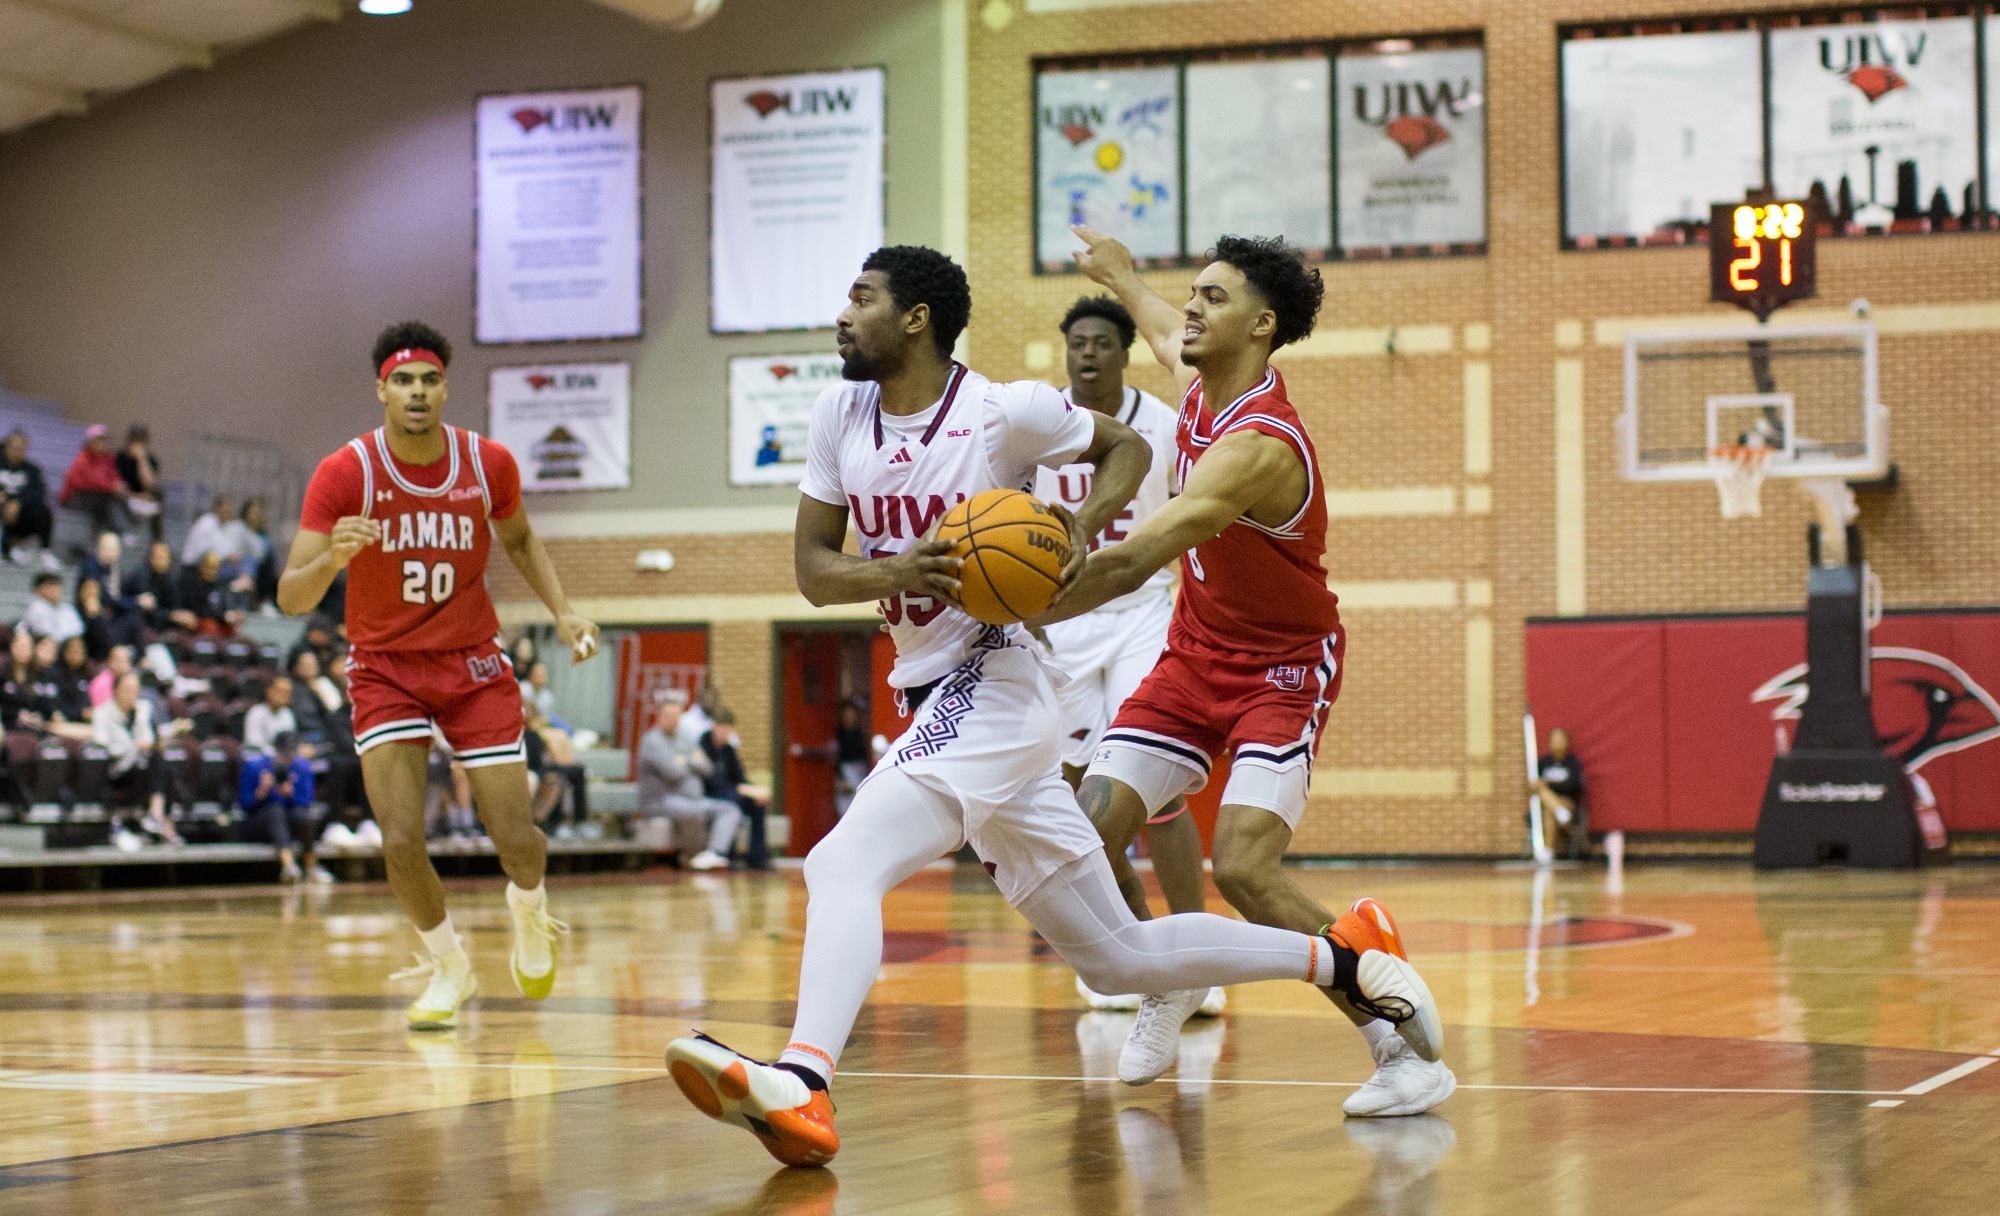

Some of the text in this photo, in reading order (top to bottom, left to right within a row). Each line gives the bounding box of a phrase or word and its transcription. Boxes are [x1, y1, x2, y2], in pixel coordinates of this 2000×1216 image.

[1819, 31, 1927, 74] UIW
[546, 101, 619, 134] UIW
[786, 84, 858, 118] UIW
[1354, 77, 1471, 126] UIW
[1729, 237, 1792, 292] 21
[946, 428, 972, 438] SLC
[381, 510, 474, 554] LAMAR
[402, 559, 456, 606] 20
